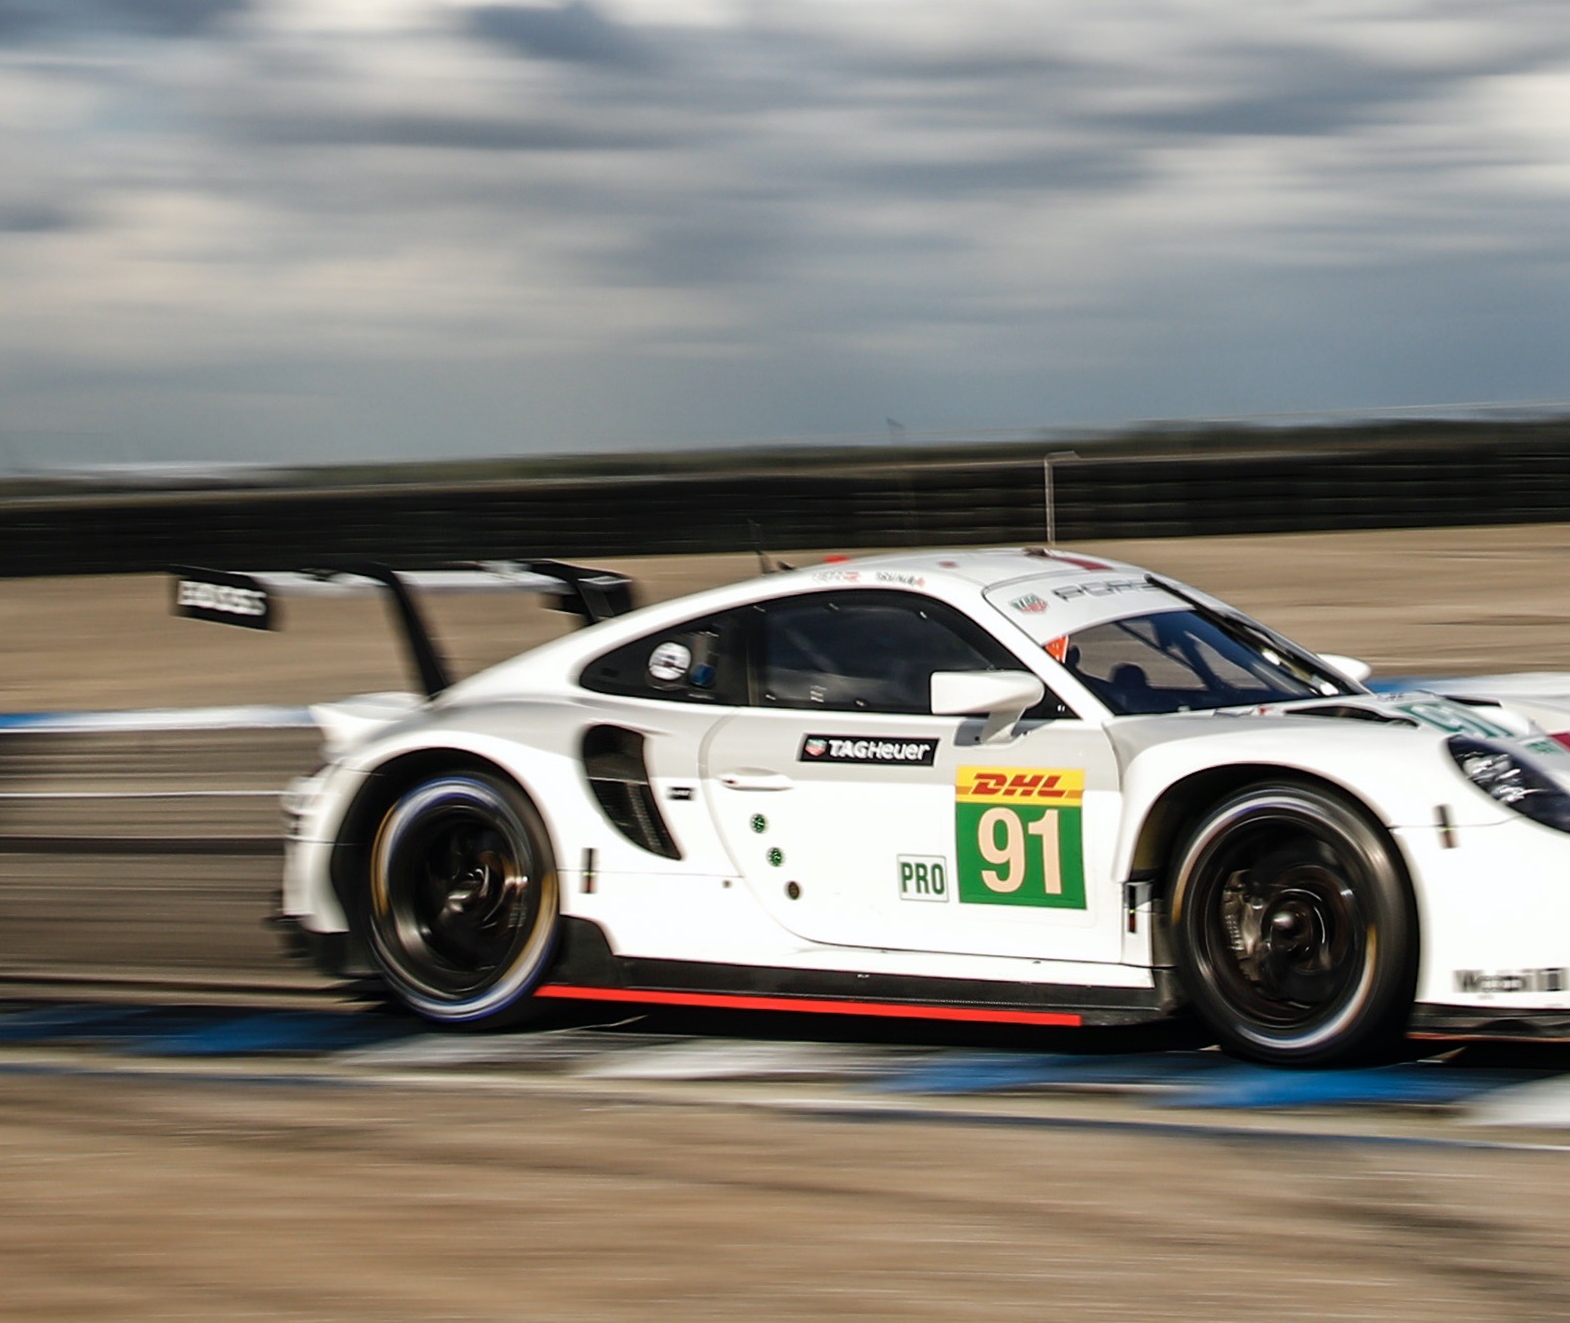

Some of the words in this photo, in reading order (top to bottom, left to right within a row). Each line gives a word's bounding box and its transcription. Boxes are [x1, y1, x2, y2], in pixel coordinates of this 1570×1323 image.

[971, 773, 1066, 798] DHL
[978, 807, 1062, 894] 91
[900, 863, 944, 894] PRO
